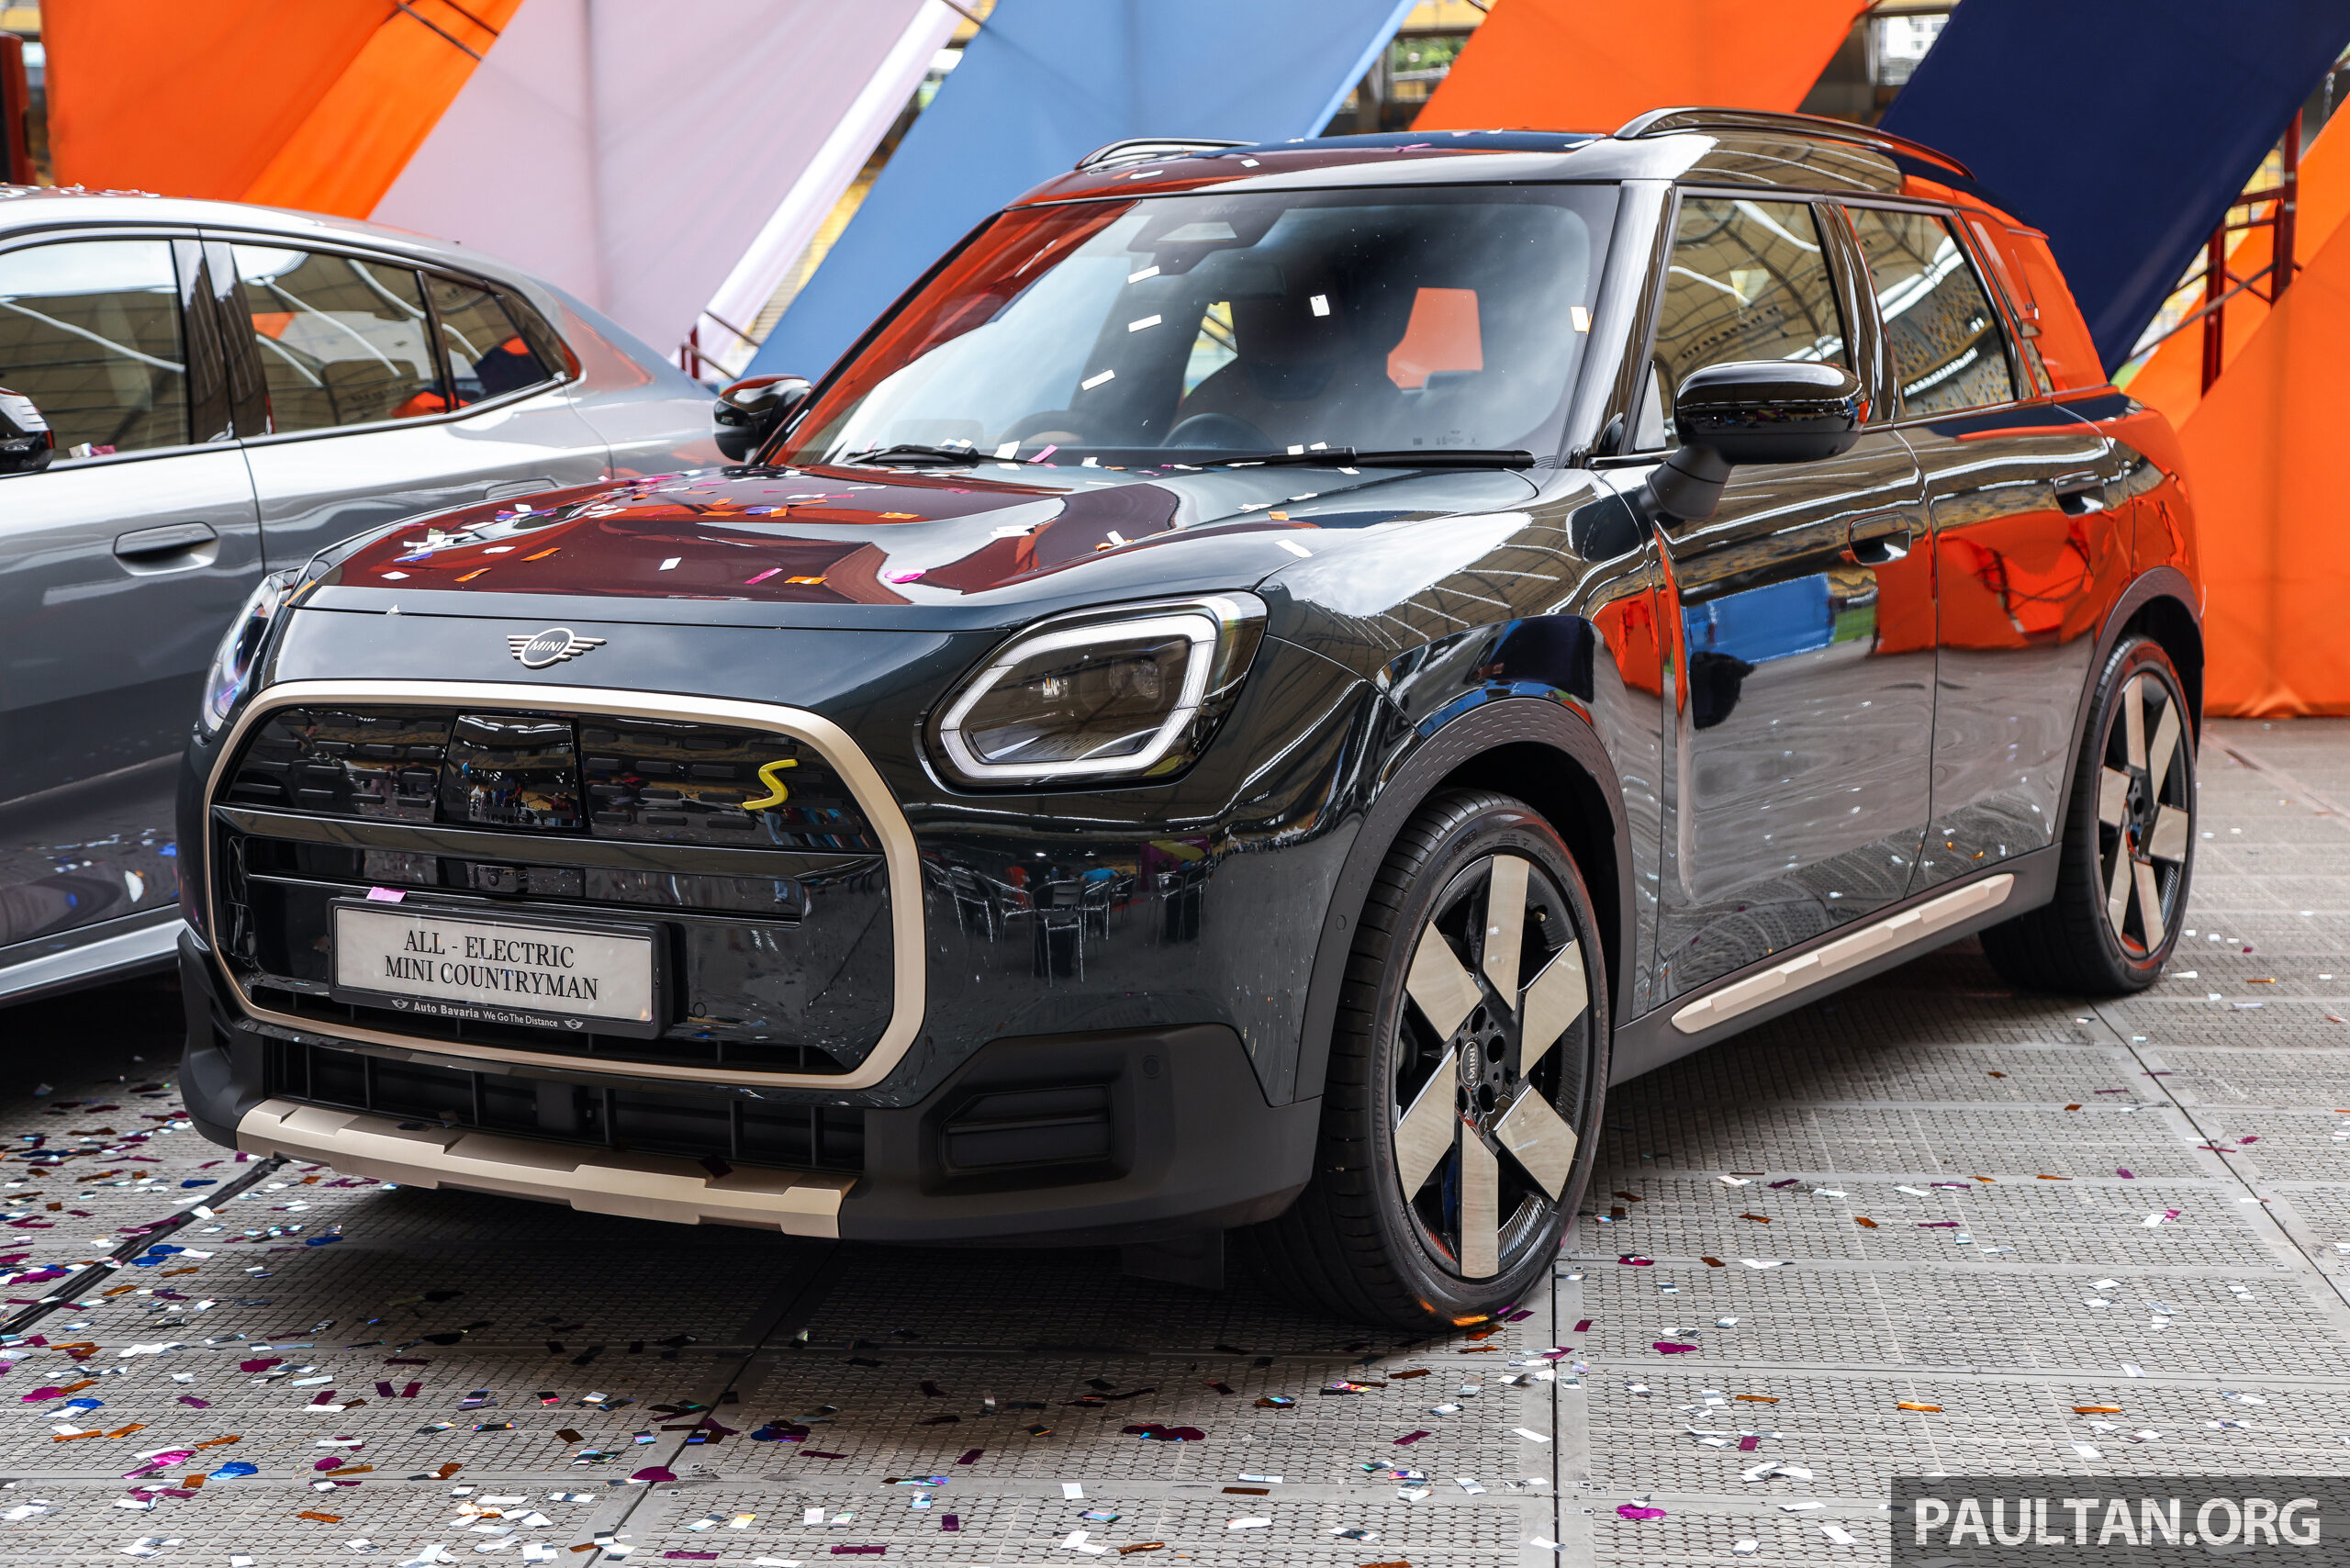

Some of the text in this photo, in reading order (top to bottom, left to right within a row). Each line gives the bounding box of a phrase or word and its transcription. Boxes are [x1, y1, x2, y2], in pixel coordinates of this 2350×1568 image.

[529, 641, 565, 652] MINI
[742, 758, 799, 810] S
[404, 929, 445, 955] ALL
[464, 935, 574, 969] ELECTRIC
[385, 955, 599, 1001] MINI COUNTRYMAN
[414, 1002, 558, 1027] Auto Bavaria We Go The Distance
[1468, 1047, 1478, 1080] MINI
